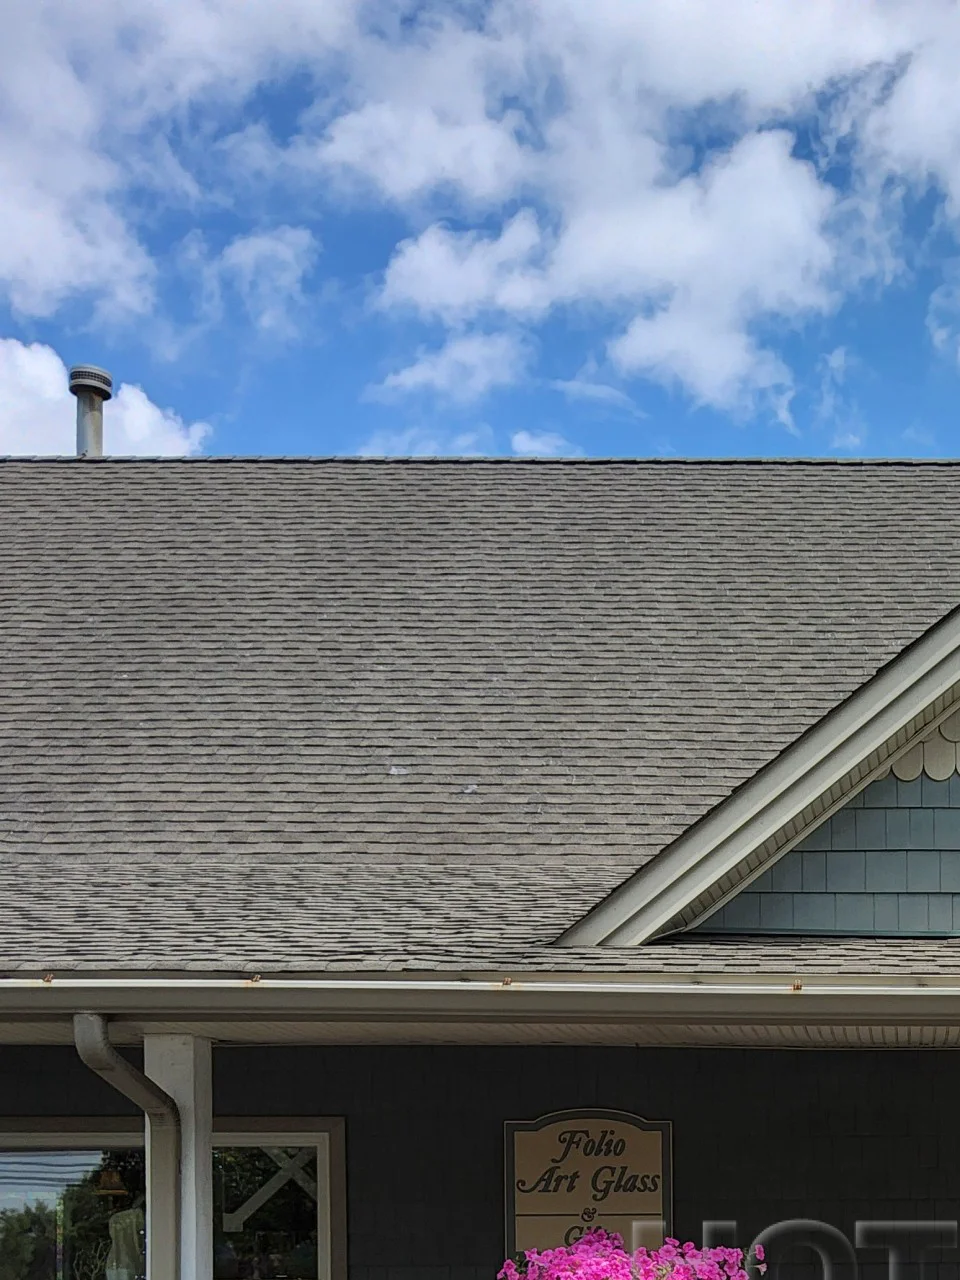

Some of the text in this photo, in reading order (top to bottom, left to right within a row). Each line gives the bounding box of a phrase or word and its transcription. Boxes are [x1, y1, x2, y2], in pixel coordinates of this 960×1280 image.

[551, 1129, 626, 1163] Folio
[516, 1165, 661, 1201] Art Glass
[581, 1207, 597, 1222] &
